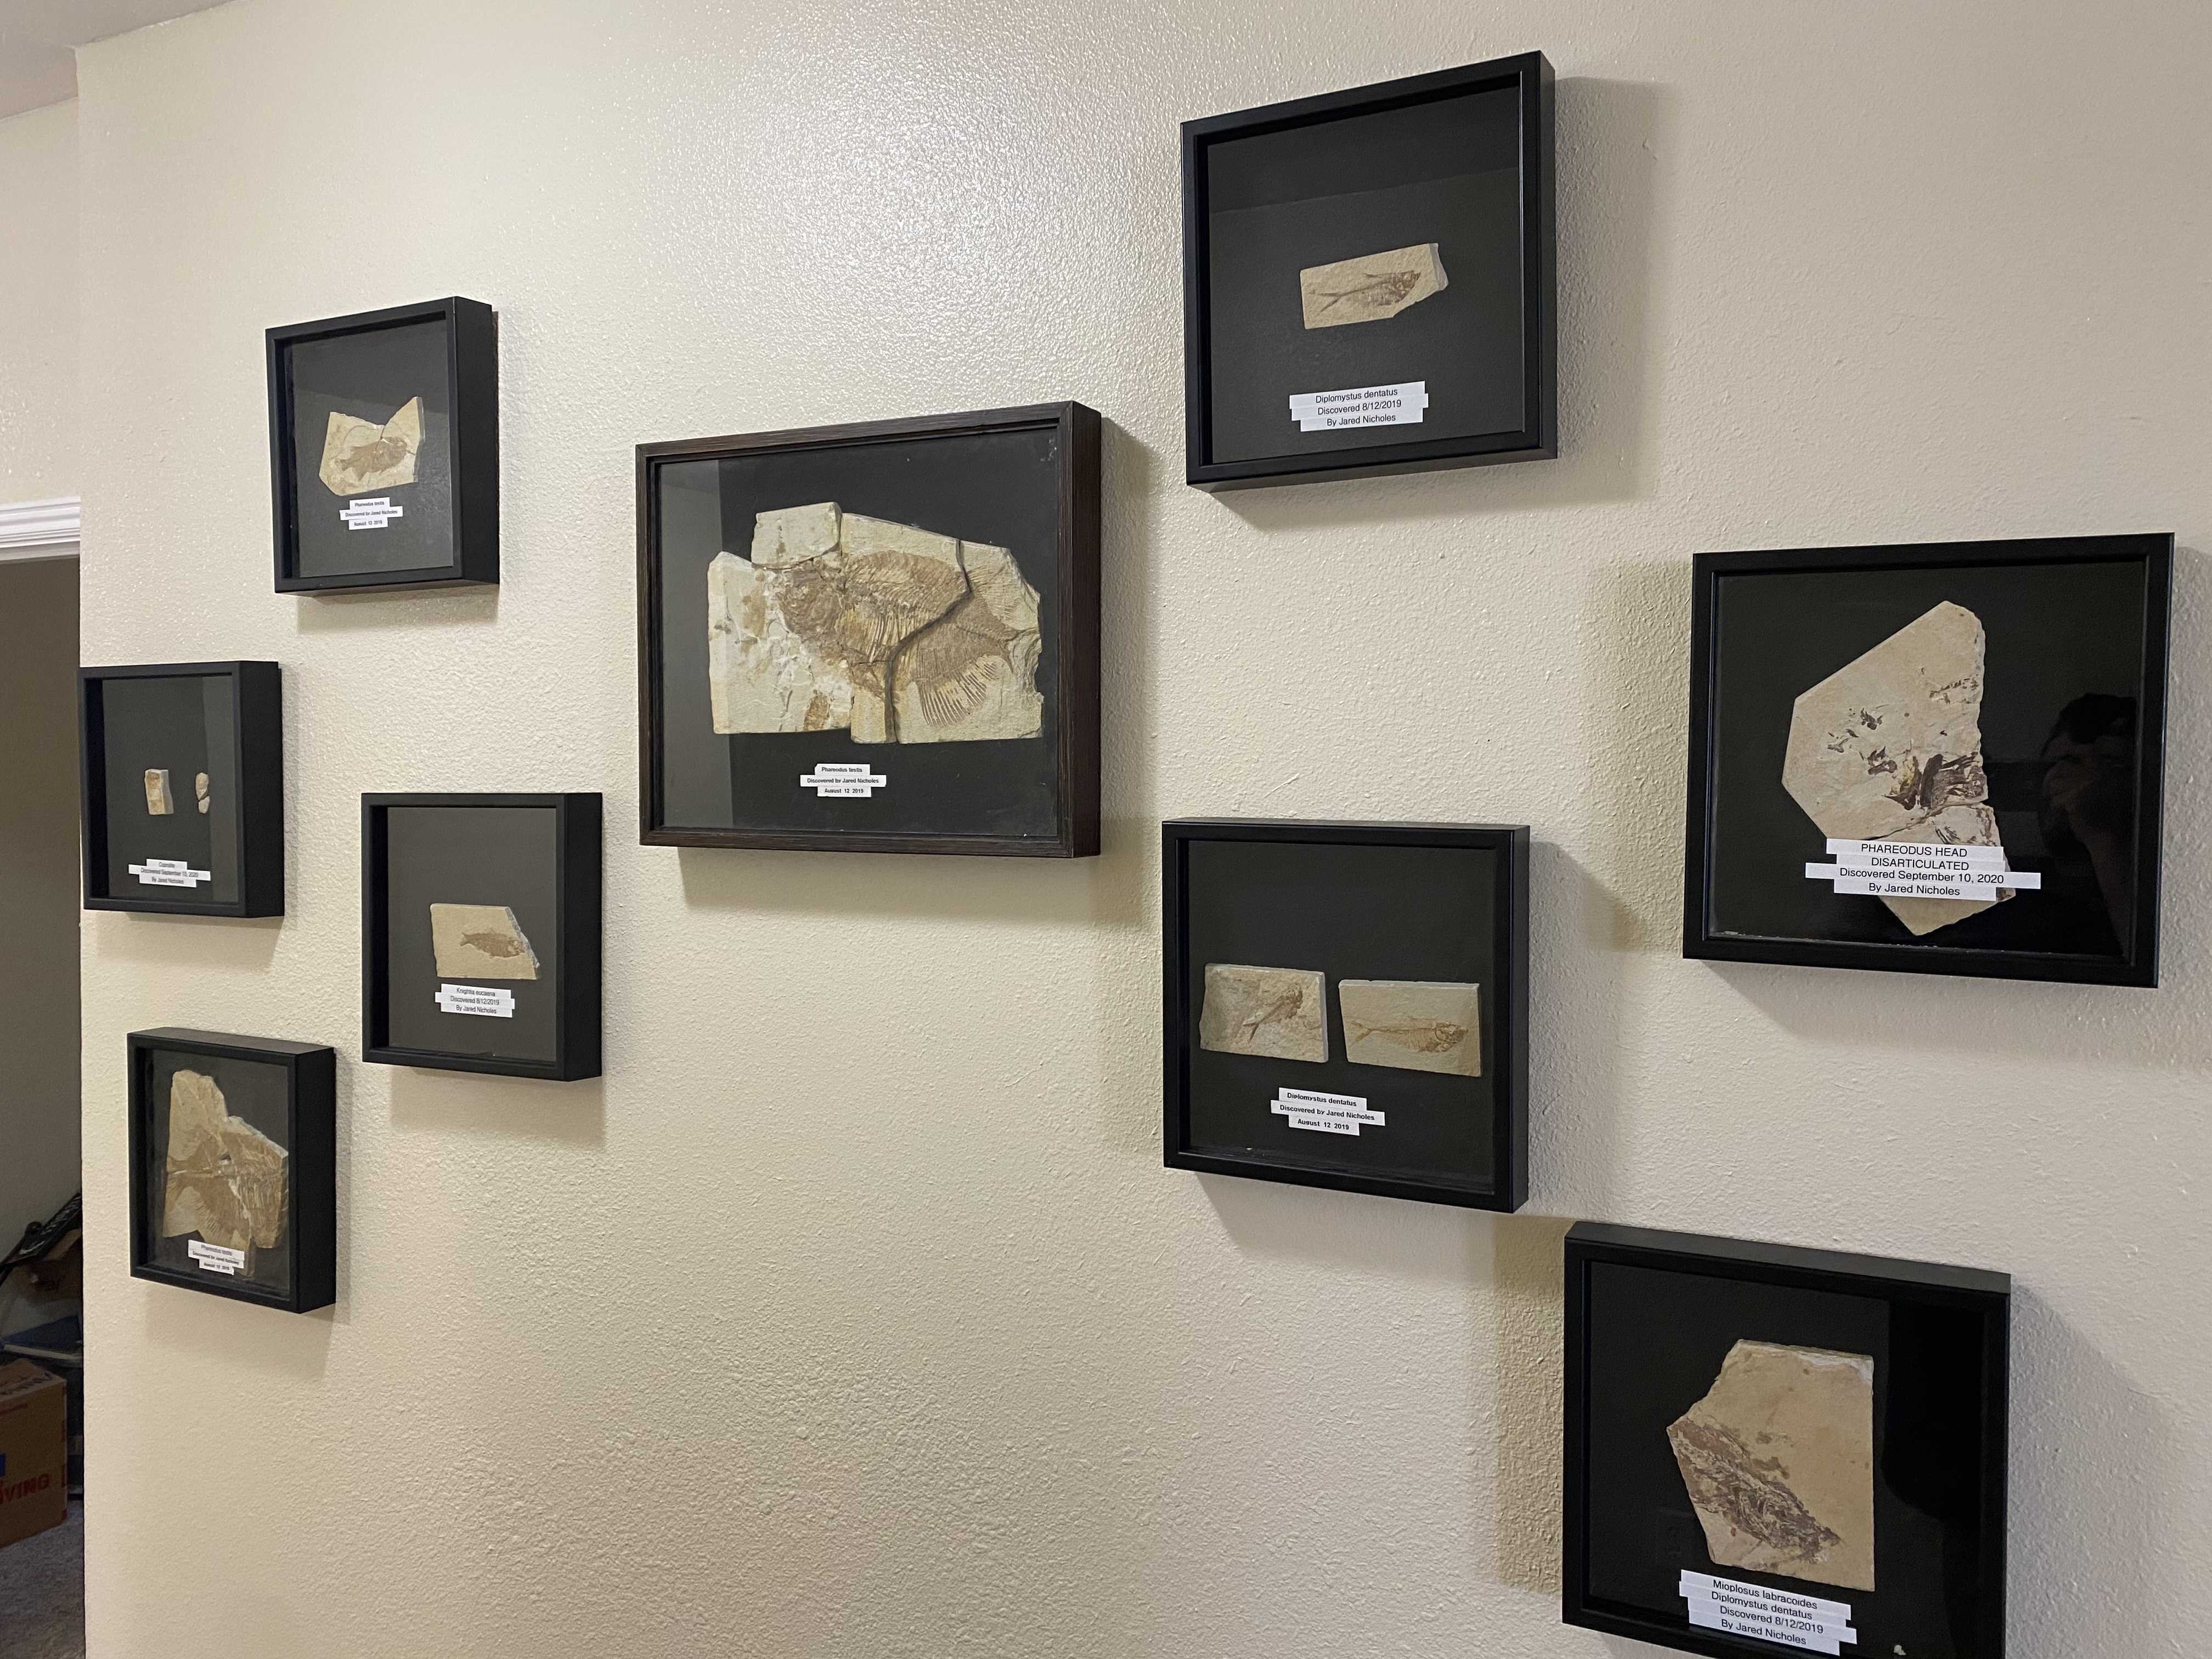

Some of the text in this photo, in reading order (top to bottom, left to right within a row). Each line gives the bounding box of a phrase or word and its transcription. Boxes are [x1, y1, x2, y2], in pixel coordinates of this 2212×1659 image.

[1316, 388, 1398, 404] Diplomystus dentatus
[1318, 399, 1402, 415] Discovered 8/12/2019
[1327, 414, 1396, 427] By Jared Nicholes
[1861, 844, 1967, 857] PHAREODUS HEAD
[1871, 857, 1969, 871] DISARTICULATED
[1840, 867, 2004, 884] Discovered September 10, 2020
[1869, 883, 1960, 896] By Jared Nicholes
[450, 995, 475, 1003] Discovered
[1287, 1092, 1357, 1107] Diplomystus dentatus
[1280, 1105, 1315, 1114] Discovered
[1346, 1112, 1375, 1120] Nicholes
[1297, 1119, 1320, 1127] August
[1713, 1579, 1818, 1610] Mioplosus labracoides
[1712, 1591, 1812, 1620] Diplomystus dentatus
[1720, 1605, 1823, 1634] Discovered 8/12/2019
[1722, 1619, 1807, 1645] By Jared Nicholes
